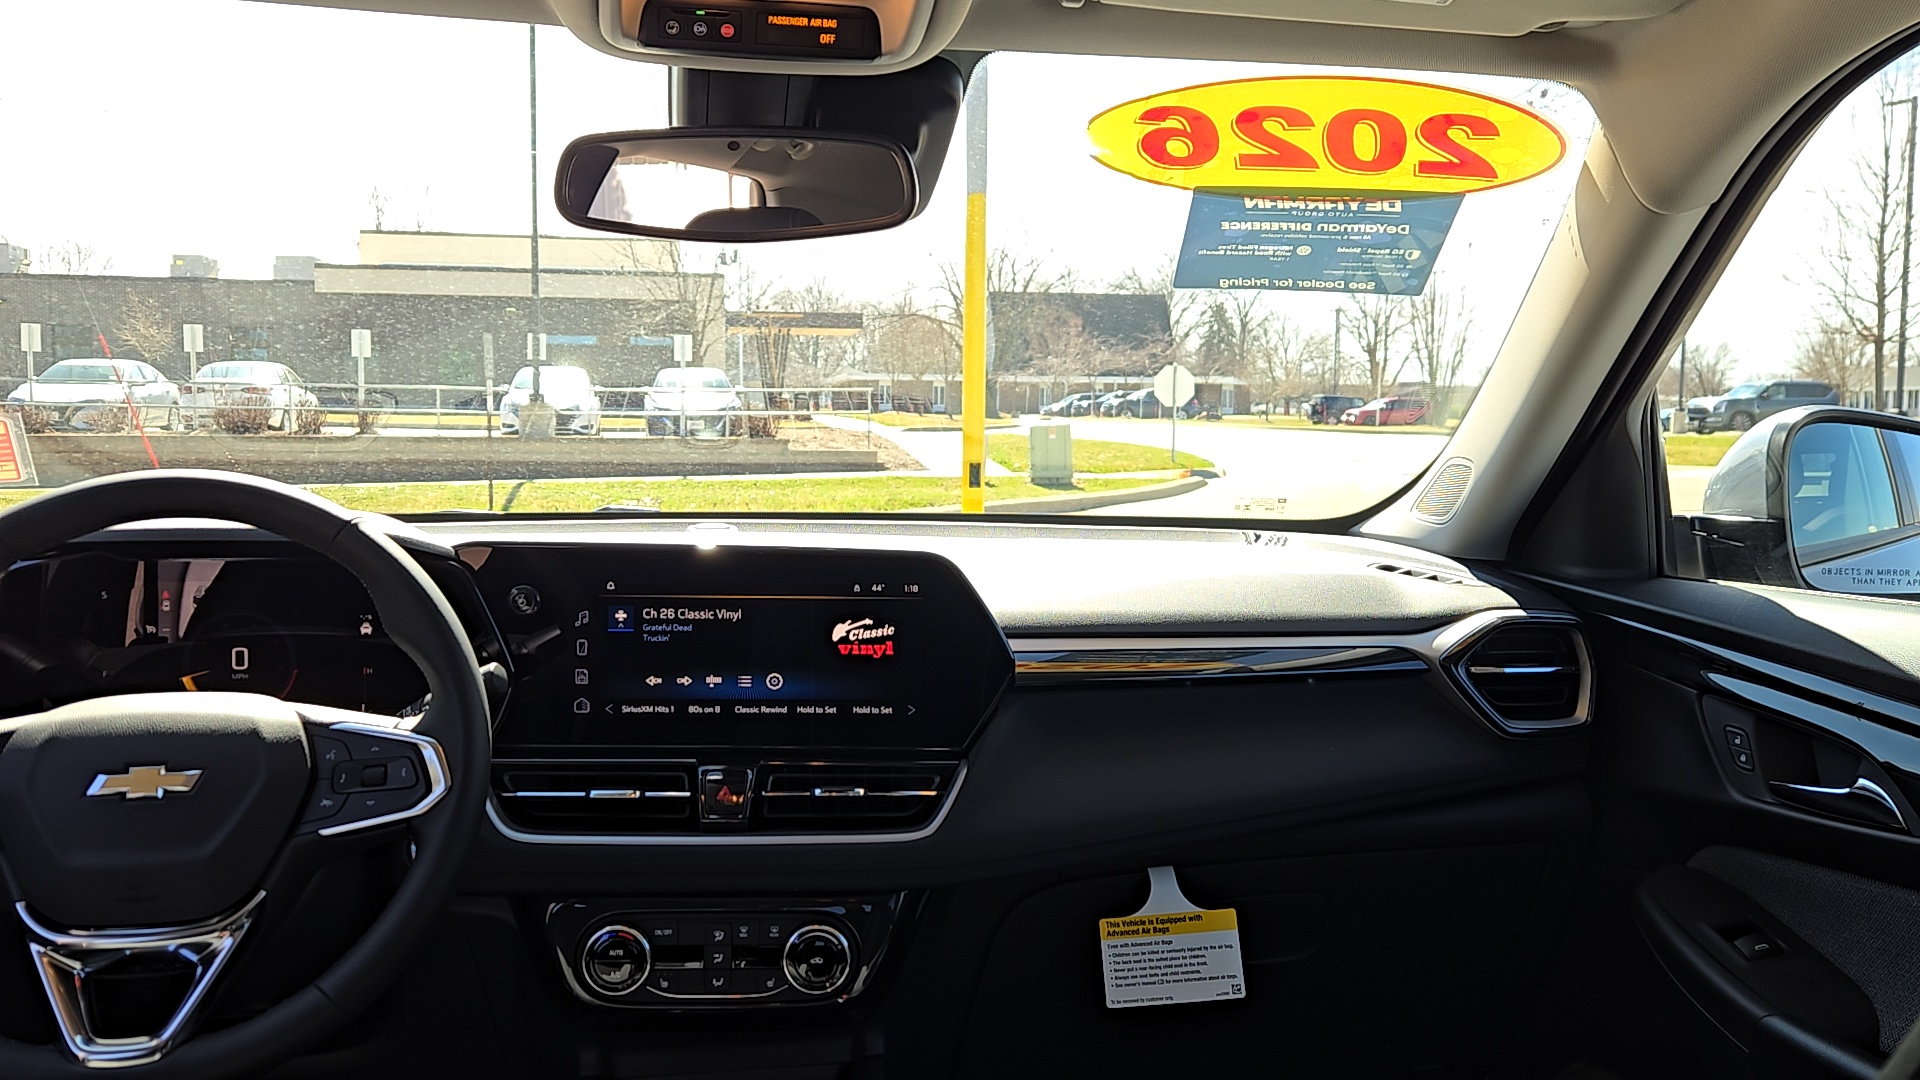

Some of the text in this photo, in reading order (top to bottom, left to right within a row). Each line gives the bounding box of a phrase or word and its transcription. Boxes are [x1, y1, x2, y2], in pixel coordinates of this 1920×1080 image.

[768, 16, 838, 28] PASSENGER AIR BAG
[820, 34, 836, 44] OFF
[1877, 568, 1910, 576] MIRROR
[642, 608, 742, 622] Ch 26 Classic Vinyl
[643, 634, 670, 642] Truckin'
[849, 624, 895, 641] Classic
[838, 641, 894, 658] vinyl
[231, 647, 249, 671] 0
[655, 705, 670, 713] Hits
[734, 706, 788, 714] Classic Rewind
[1121, 919, 1146, 928] Vehicle
[1156, 915, 1187, 925] Equipped
[1188, 914, 1203, 922] with
[1106, 928, 1140, 937] Advanced
[1153, 926, 1170, 934] Bags
